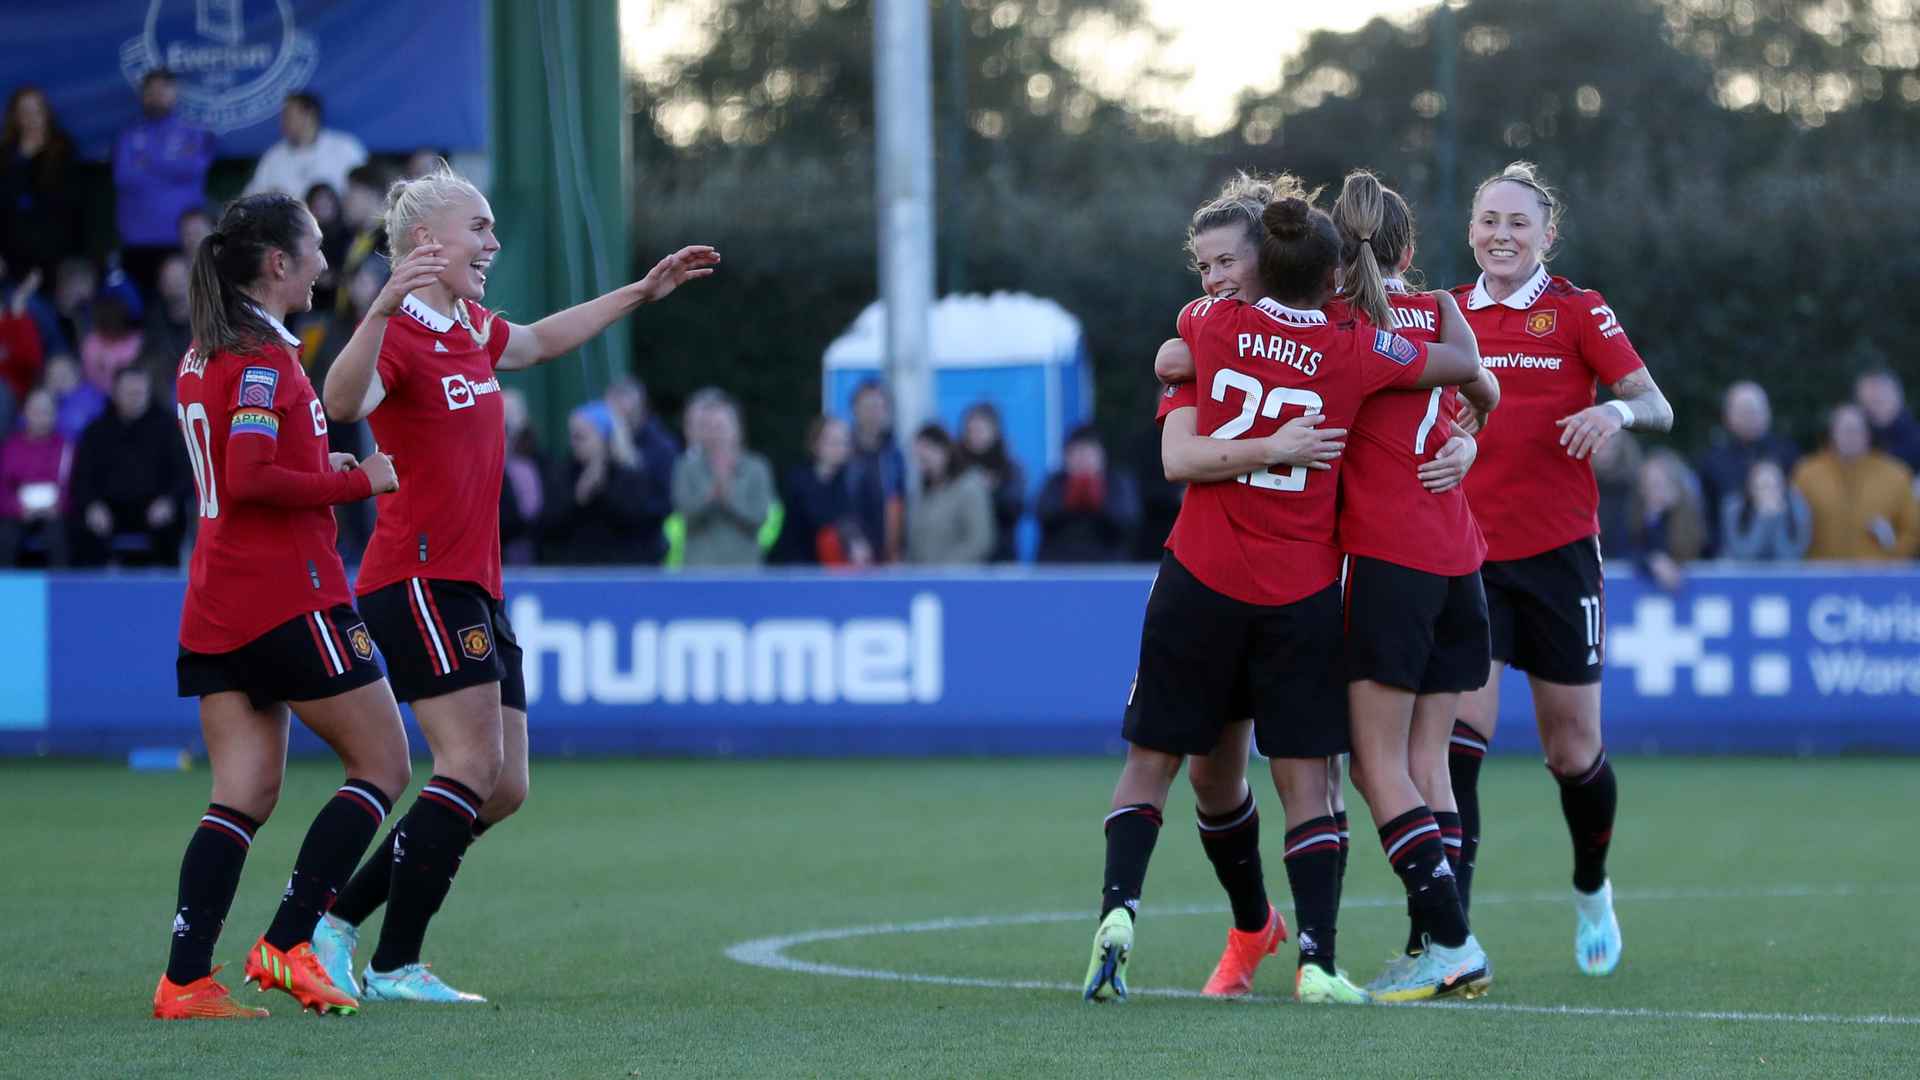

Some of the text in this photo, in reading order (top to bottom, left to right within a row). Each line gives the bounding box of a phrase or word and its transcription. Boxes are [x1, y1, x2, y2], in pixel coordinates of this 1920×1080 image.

[1389, 307, 1436, 332] OONE
[1237, 332, 1323, 377] PARRIS
[1479, 352, 1563, 370] eamViewer
[1580, 596, 1601, 647] 11
[511, 593, 944, 706] hummel
